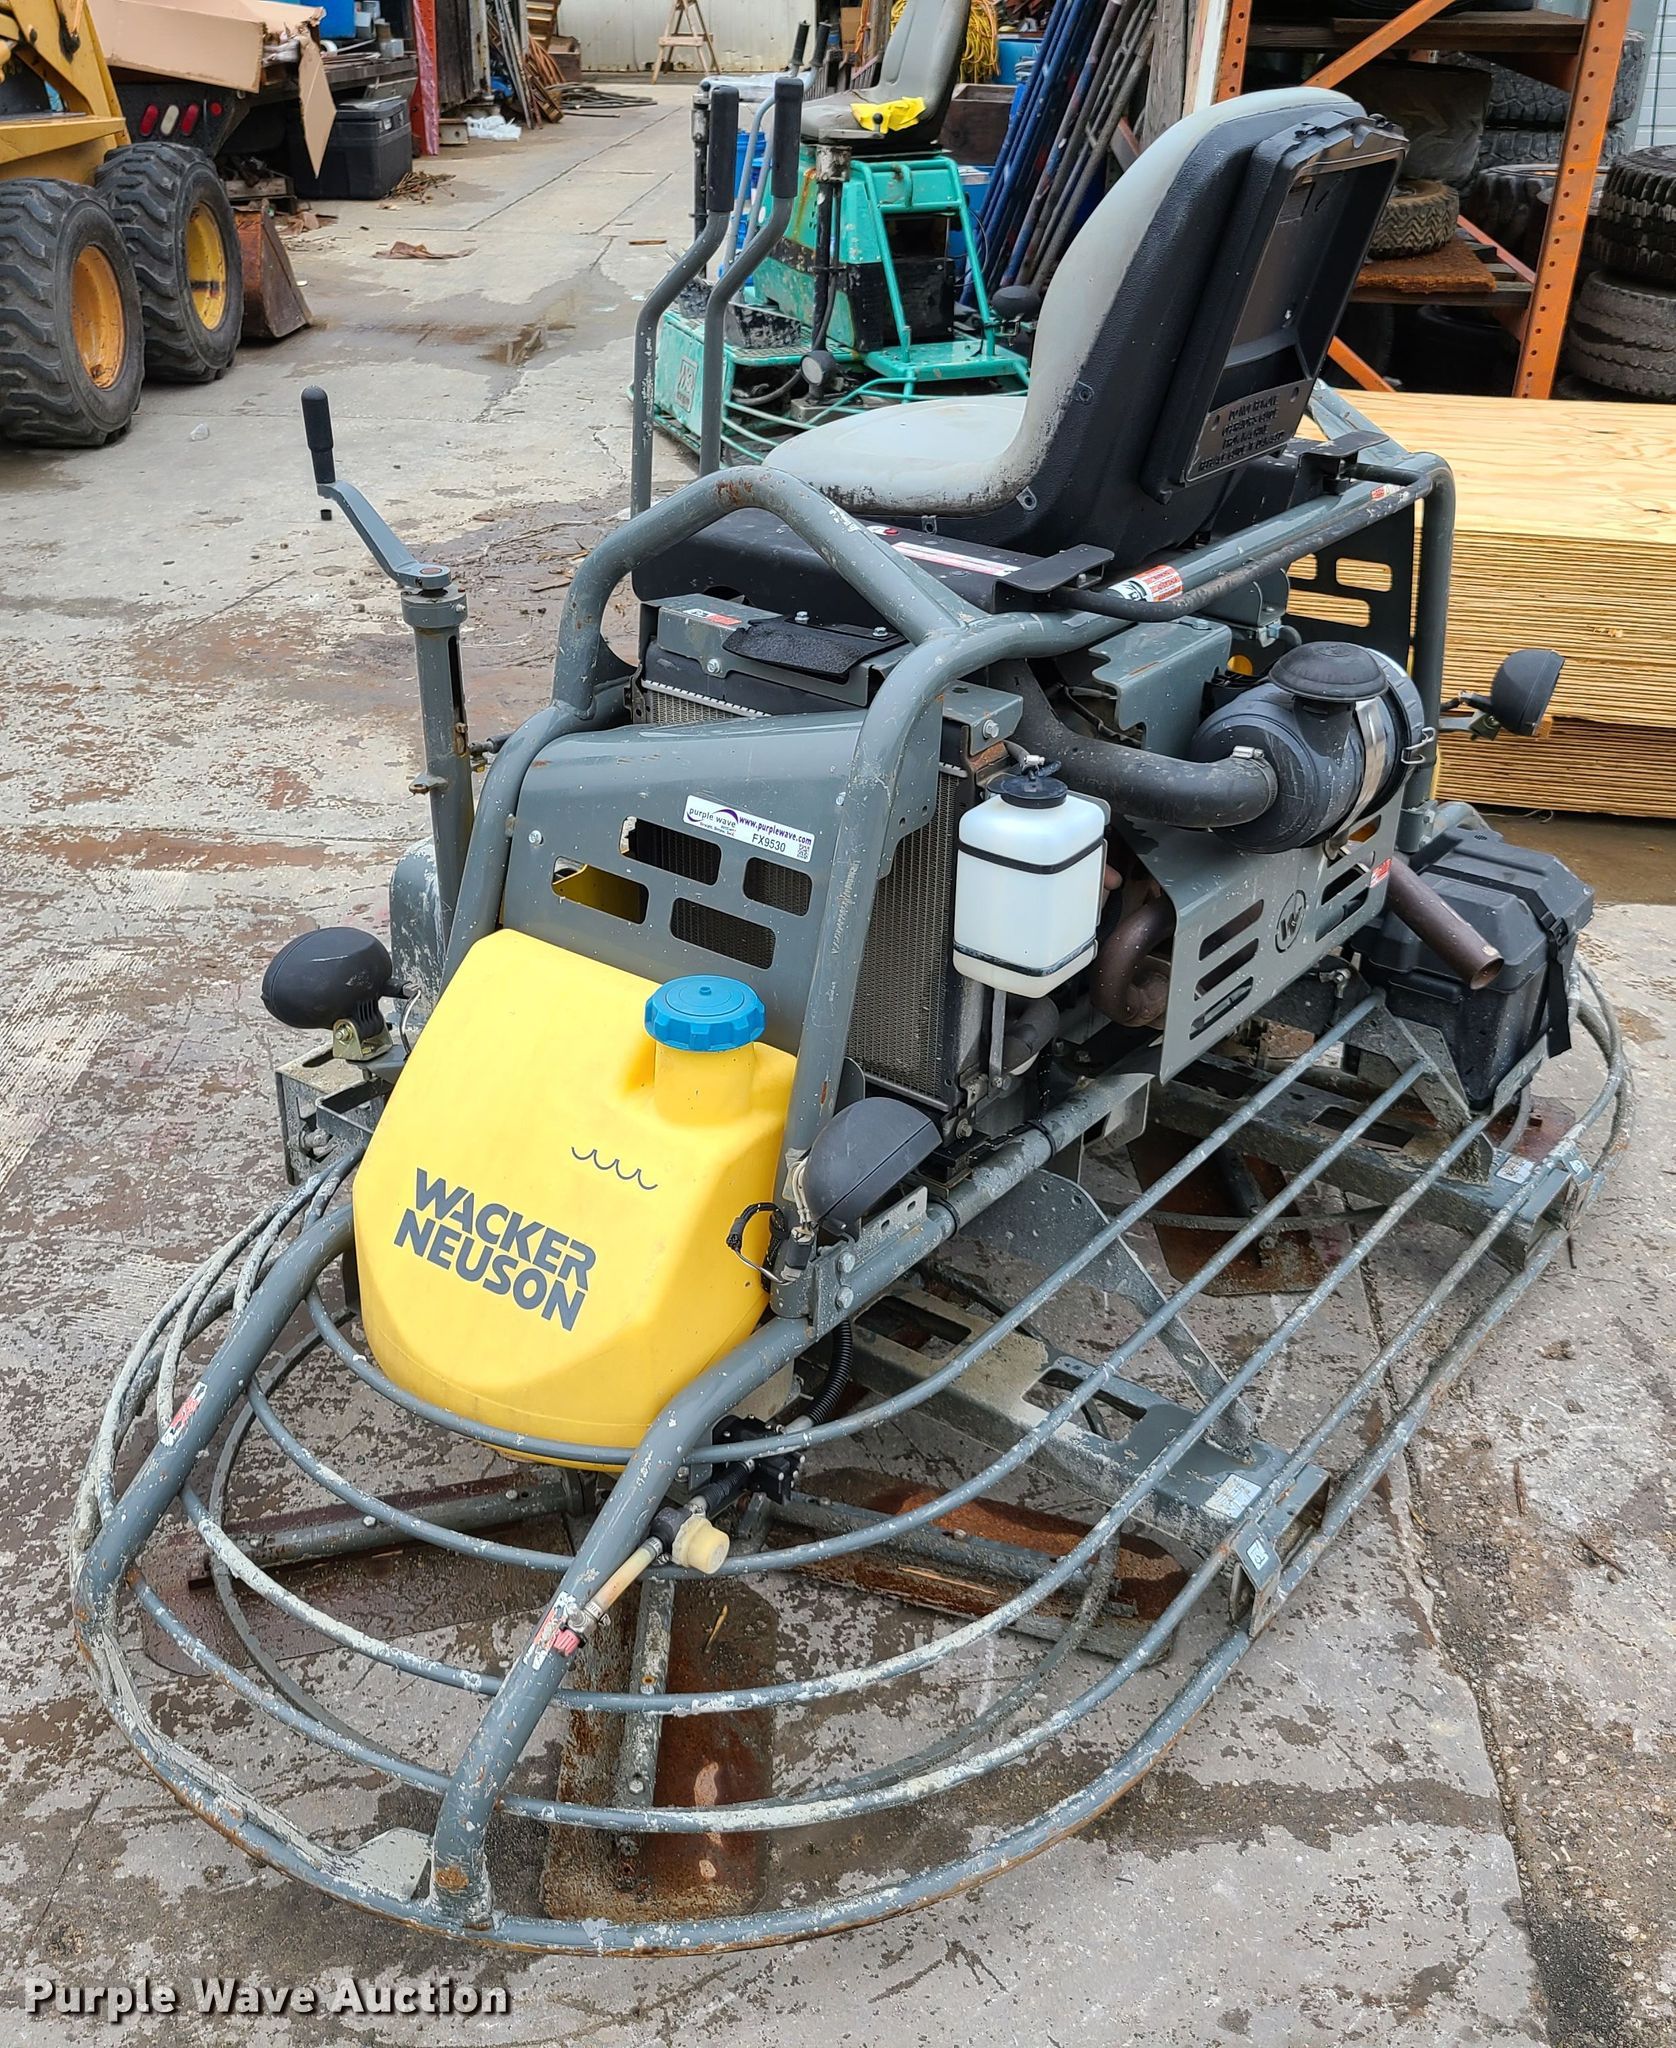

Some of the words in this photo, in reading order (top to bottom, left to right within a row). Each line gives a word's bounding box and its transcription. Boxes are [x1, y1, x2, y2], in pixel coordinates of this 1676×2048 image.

[689, 808, 714, 822] purple
[716, 817, 737, 828] wave
[739, 816, 812, 845] www.purplewave.com
[752, 833, 786, 852] FX9530
[415, 1167, 596, 1291] WACKER
[393, 1208, 585, 1332] NEUSON
